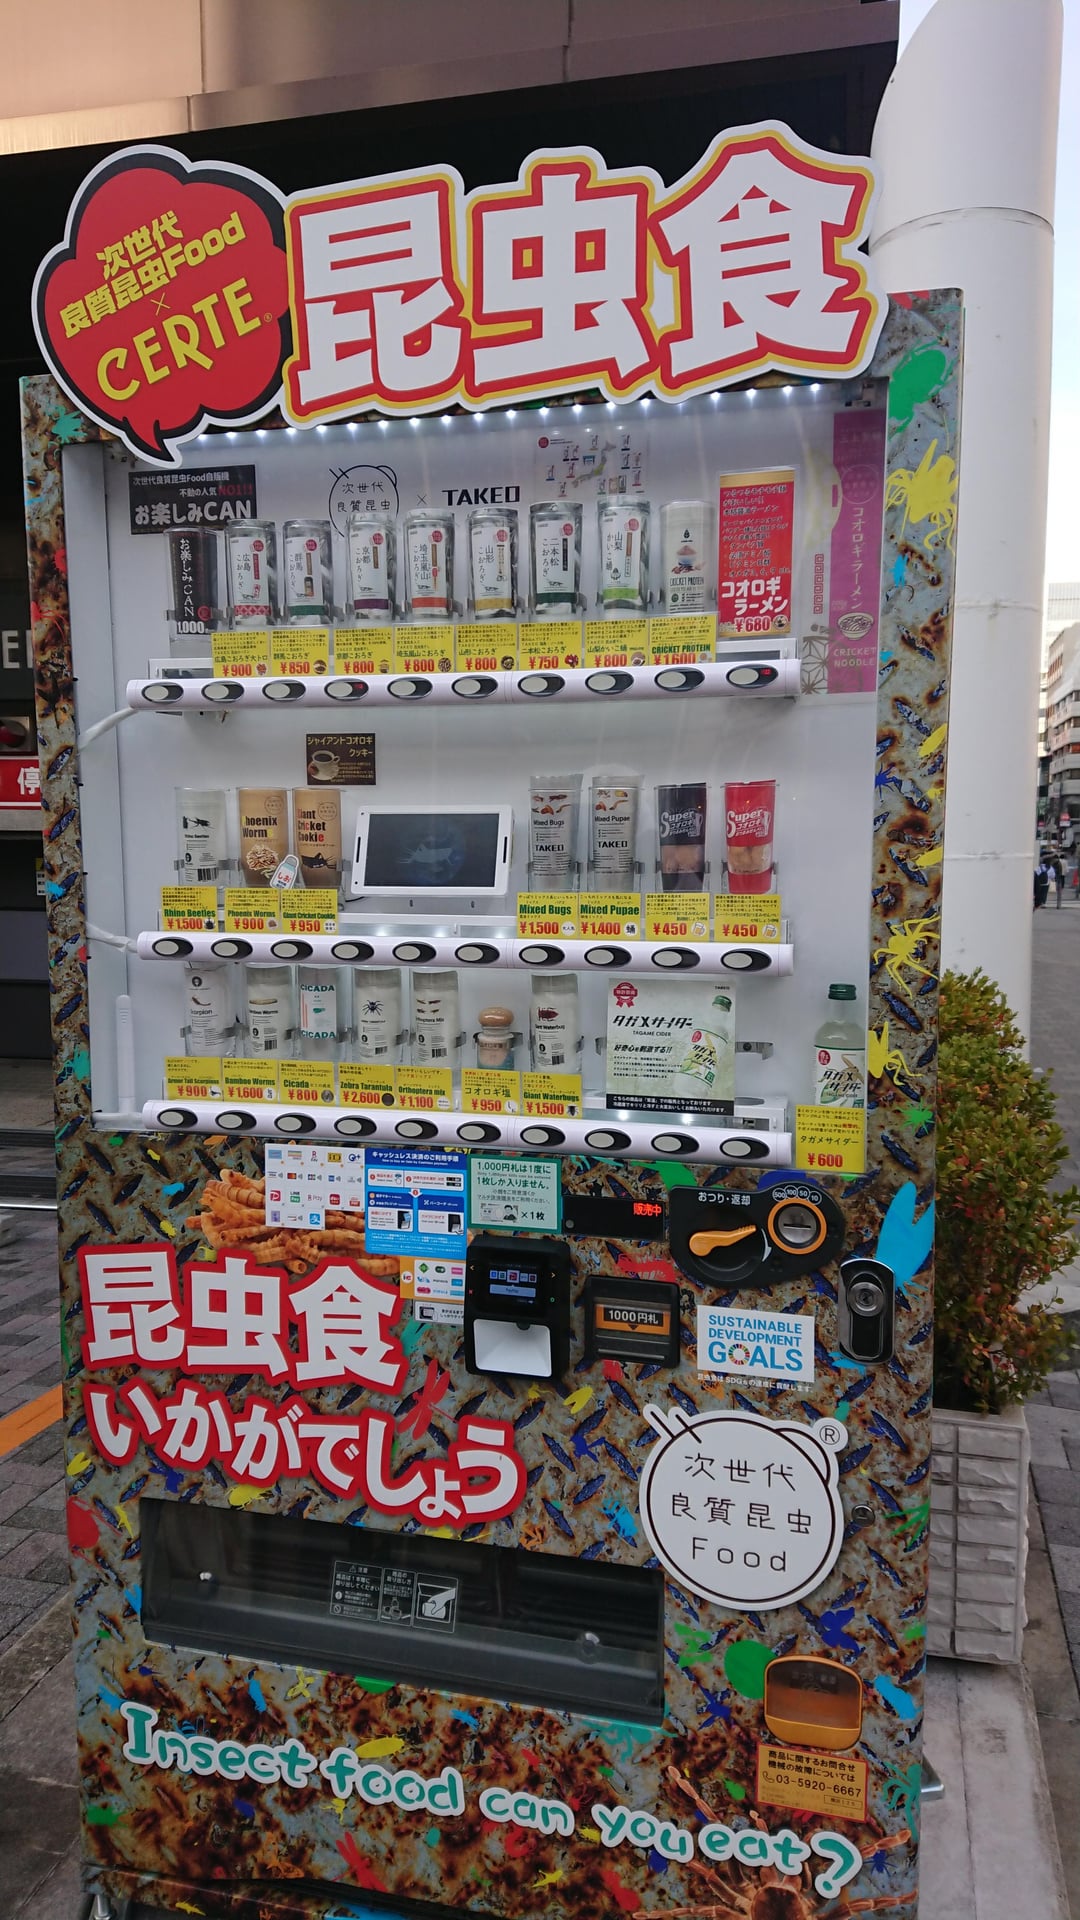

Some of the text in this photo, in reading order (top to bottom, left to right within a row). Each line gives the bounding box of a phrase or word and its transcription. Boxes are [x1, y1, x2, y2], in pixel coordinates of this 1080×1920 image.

[96, 210, 183, 281] 次世代
[59, 211, 246, 338] 良質昆虫Food
[296, 147, 863, 404] 昆虫食
[97, 277, 261, 401] CERTE
[133, 471, 230, 486] 次世代良質昆虫Food自販機
[342, 482, 385, 494] 次世代
[442, 486, 520, 506] TAKEO
[135, 500, 251, 526] お楽しみCAN
[337, 499, 391, 513] 良質昆虫
[850, 507, 866, 610] コオロギラーメン
[721, 576, 781, 598] コオロギ
[734, 596, 788, 616] ラーメン
[734, 616, 772, 633] ¥680
[652, 644, 711, 654] CRICKET PROTEIN
[280, 661, 310, 675] ¥850
[528, 655, 559, 670] ¥750
[222, 663, 252, 677] ¥900
[349, 748, 373, 757] クッキー
[660, 810, 694, 838] Super
[727, 809, 763, 838] Super
[164, 908, 216, 918] Rhino Beetles
[227, 909, 276, 918] Phoenix Worms
[519, 904, 548, 915] Mixed
[549, 904, 572, 917] Bugs
[580, 904, 640, 917] Mixed Pupae
[234, 918, 264, 930] ¥900
[290, 920, 320, 932] ¥950
[519, 921, 559, 935] ¥1,500
[580, 922, 621, 935] ¥1,400
[653, 922, 687, 936] ¥450
[722, 924, 758, 937] ¥450
[300, 984, 335, 992] CICADA
[613, 1015, 693, 1029] タガメサイダー
[300, 1030, 336, 1039] CICADA
[823, 1070, 853, 1082] タガメ
[283, 1079, 309, 1088] Cicada
[340, 1081, 360, 1090] Zebra
[361, 1082, 393, 1092] Tarantula
[288, 1089, 318, 1101] ¥800
[343, 1091, 380, 1105] ¥2,600
[398, 1086, 446, 1096] Orthoptera mix
[465, 1087, 511, 1098] コオロギ塩
[523, 1091, 580, 1102] Giant Waterbugs
[400, 1095, 433, 1108] ¥1,100
[471, 1098, 501, 1112] ¥950
[526, 1101, 565, 1115] ¥1,500
[800, 1135, 860, 1146] タガメサイダー
[807, 1152, 844, 1168] ¥600
[477, 1177, 550, 1190] 1枚しか入りません。
[698, 1191, 751, 1206] おつり・返却
[774, 1191, 786, 1199] 500
[786, 1188, 797, 1196] 100
[799, 1189, 809, 1197] 50
[633, 1202, 662, 1217] 販売中
[84, 1251, 402, 1387] 昆虫食
[608, 1310, 659, 1325] 1000円札
[708, 1314, 802, 1335] SUSTAINABLE
[708, 1328, 802, 1347] DEVELOPMENT
[708, 1341, 803, 1372] GOALS
[89, 1385, 519, 1520] いかがでしょう
[684, 1452, 796, 1492] 次世代
[671, 1492, 812, 1535] 良質昆虫
[692, 1537, 787, 1573] Food
[768, 1750, 856, 1773] 商品に関するお問合せ
[768, 1760, 856, 1782] 機械の故障については
[776, 1774, 862, 1798] 03-5920-6667
[123, 1704, 859, 1895] Insect food can you eat?
